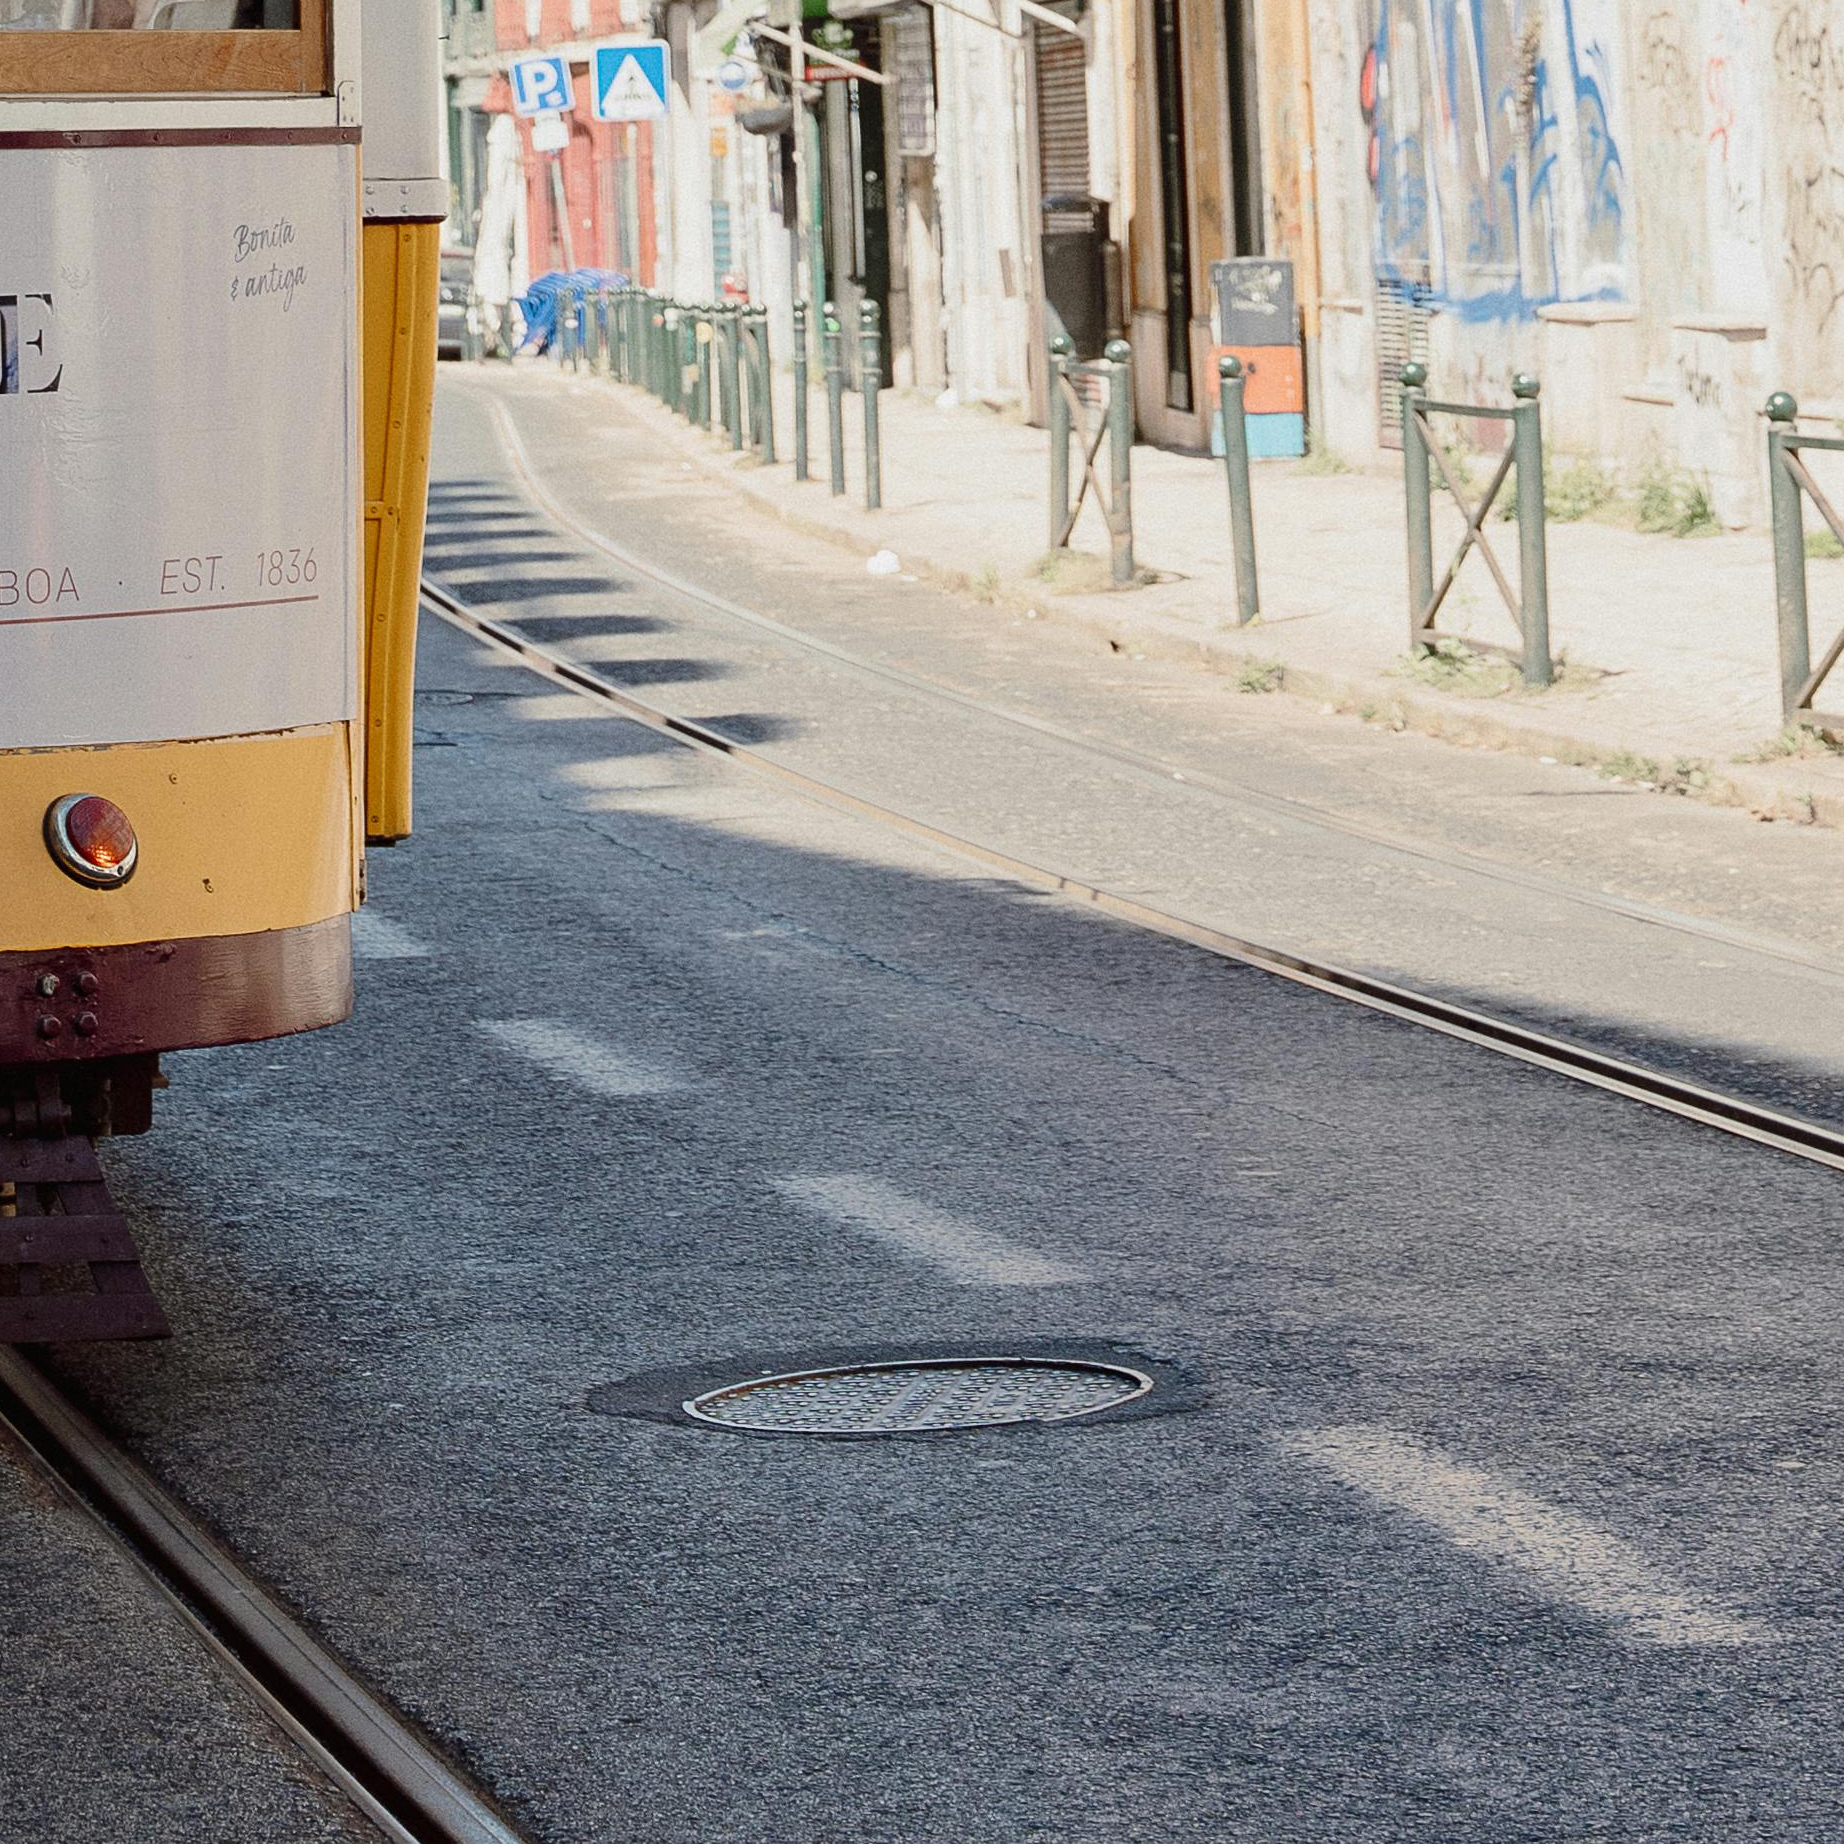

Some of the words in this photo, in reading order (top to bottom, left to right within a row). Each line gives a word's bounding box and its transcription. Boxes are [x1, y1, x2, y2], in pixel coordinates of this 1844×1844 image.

[520, 61, 558, 111] P
[233, 217, 295, 263] Bonita
[245, 263, 307, 313] antiga
[159, 554, 227, 597] EST.
[256, 546, 319, 588] 1836
